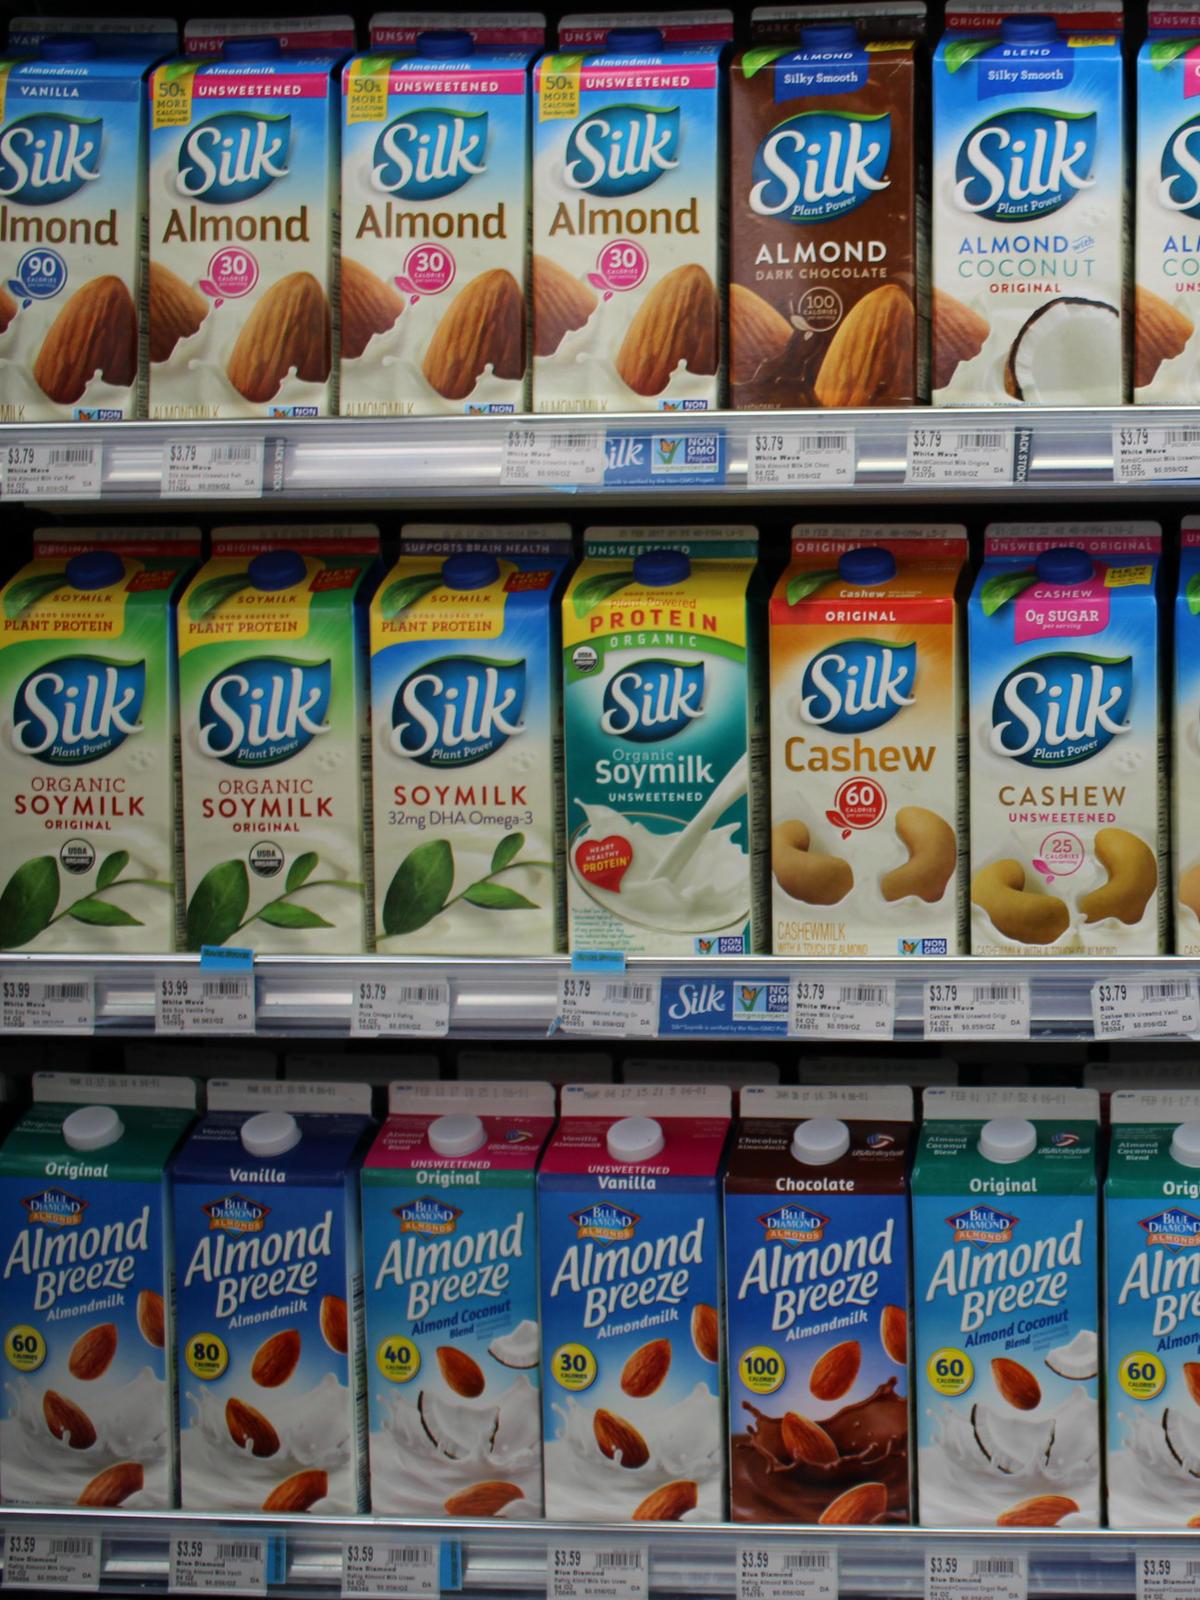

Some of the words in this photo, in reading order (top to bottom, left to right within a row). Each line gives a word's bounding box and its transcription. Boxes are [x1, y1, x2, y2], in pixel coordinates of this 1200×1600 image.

[1002, 48, 1050, 57] BLEND
[784, 73, 812, 86] Silky
[815, 72, 858, 83] Smooth
[21, 85, 80, 98] VANILLA
[199, 84, 301, 96] UNSWEETENED
[157, 99, 188, 110] MORE
[749, 122, 890, 216] Silk
[792, 203, 821, 217] Plant
[825, 196, 856, 213] Power
[163, 205, 308, 245] Almond
[754, 241, 887, 265] ALMOND
[959, 236, 1068, 254] ALMOND
[29, 259, 55, 277] 90
[755, 269, 794, 281] DARK
[799, 267, 887, 279] CHOCOLATE
[958, 259, 1095, 278] COCONUT
[989, 283, 1061, 293] ORIGINAL
[913, 430, 942, 447] $3.79
[237, 595, 297, 604] SOYMILK
[590, 610, 717, 632] PROTEIN
[824, 611, 896, 622] ORIGINAL
[189, 623, 235, 633] PLANT
[239, 622, 297, 632] PROTEIN
[11, 668, 144, 754] Silk
[613, 750, 673, 763] Organic
[785, 737, 936, 772] Cashew
[596, 757, 713, 788] Soymilk
[31, 778, 126, 792] ORGANIC
[846, 787, 871, 805] 60
[999, 786, 1125, 806] CASHEW
[15, 796, 144, 816] SOYMILK
[845, 806, 877, 814] CALORIES
[44, 820, 112, 831] ORIGINAL
[388, 812, 425, 830] 32mg
[430, 811, 465, 825] DHA
[469, 812, 533, 829] Omega-3
[583, 859, 627, 873] PROTEIN
[778, 923, 845, 940] CASHEWMILK
[162, 981, 188, 996] $3.99
[930, 986, 957, 1001] $3.79
[669, 984, 725, 1019] Silk
[416, 1170, 480, 1188] Original
[776, 1178, 854, 1191] Chocolate
[781, 1210, 806, 1220] BLUE
[767, 1219, 820, 1229] DIAMOND
[4, 1206, 149, 1279] Almond
[770, 1230, 819, 1241] ALMONDS
[34, 1256, 134, 1311] Breeze
[785, 1310, 868, 1342] Almondmilk
[745, 1358, 778, 1375] 100
[177, 1541, 202, 1557] $3.59
[742, 1552, 769, 1567] $3.59
